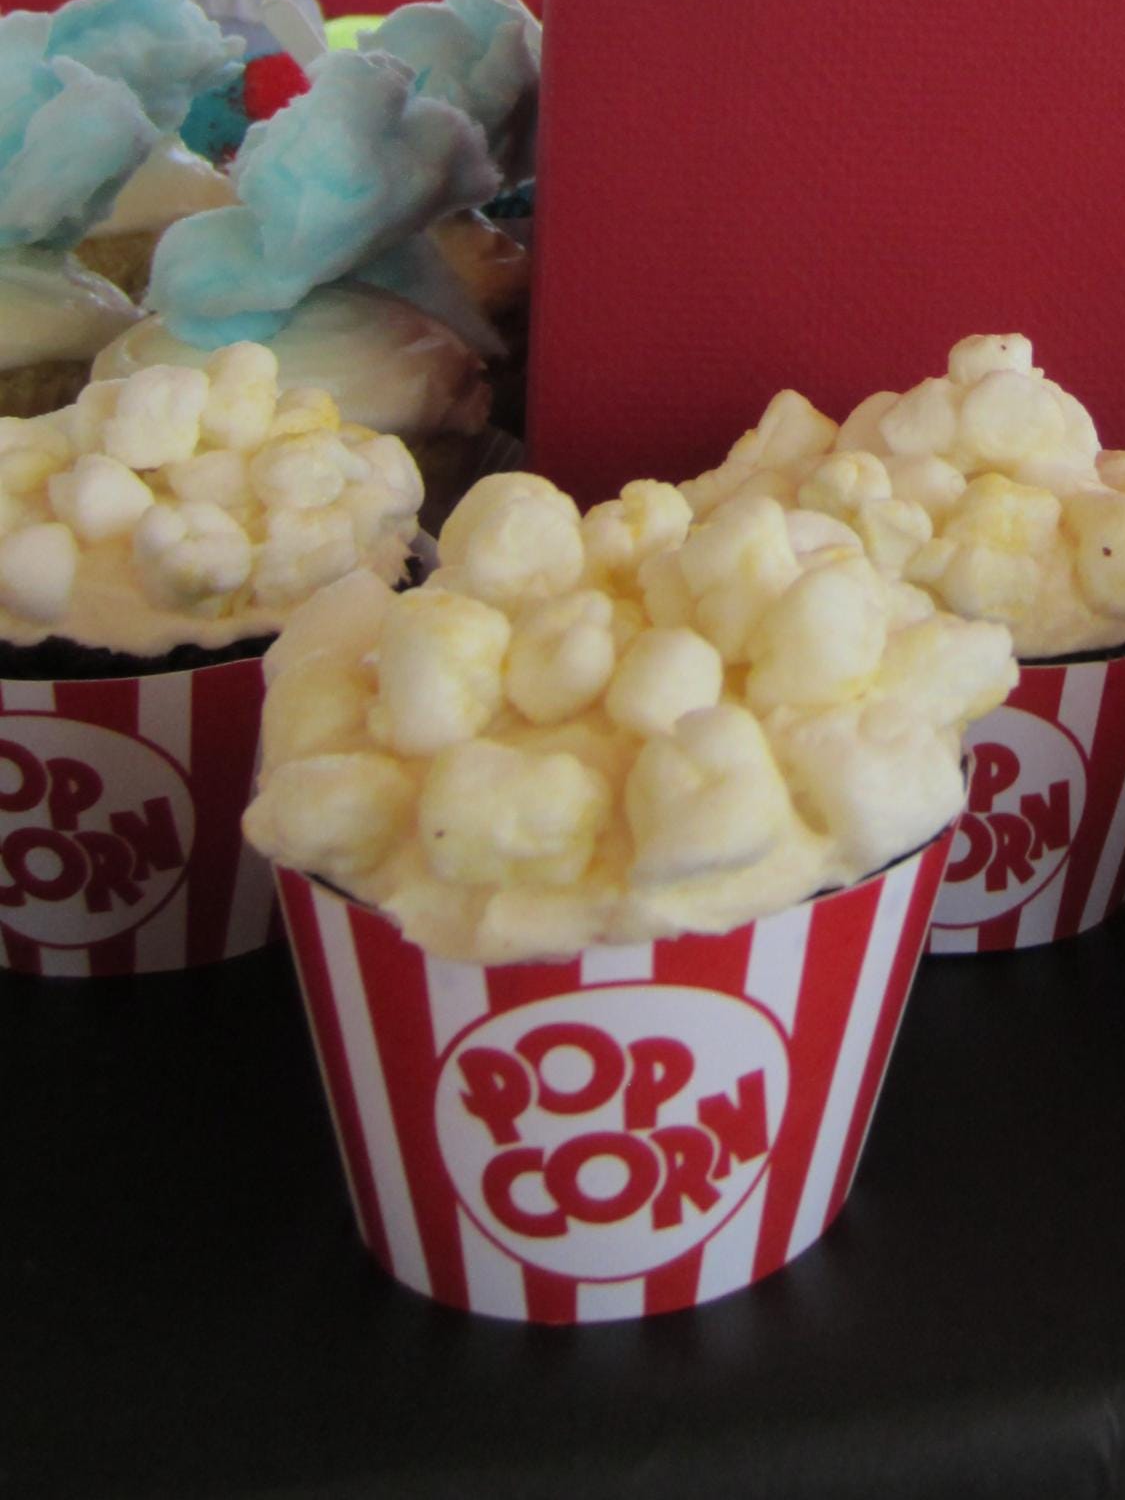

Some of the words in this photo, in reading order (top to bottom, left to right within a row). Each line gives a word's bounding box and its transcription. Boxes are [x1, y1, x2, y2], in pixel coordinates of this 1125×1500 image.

[0, 738, 104, 831] OP
[944, 779, 1071, 892] ORN
[0, 796, 187, 914] ORN
[457, 1022, 695, 1145] POP
[482, 1068, 769, 1238] CORN
